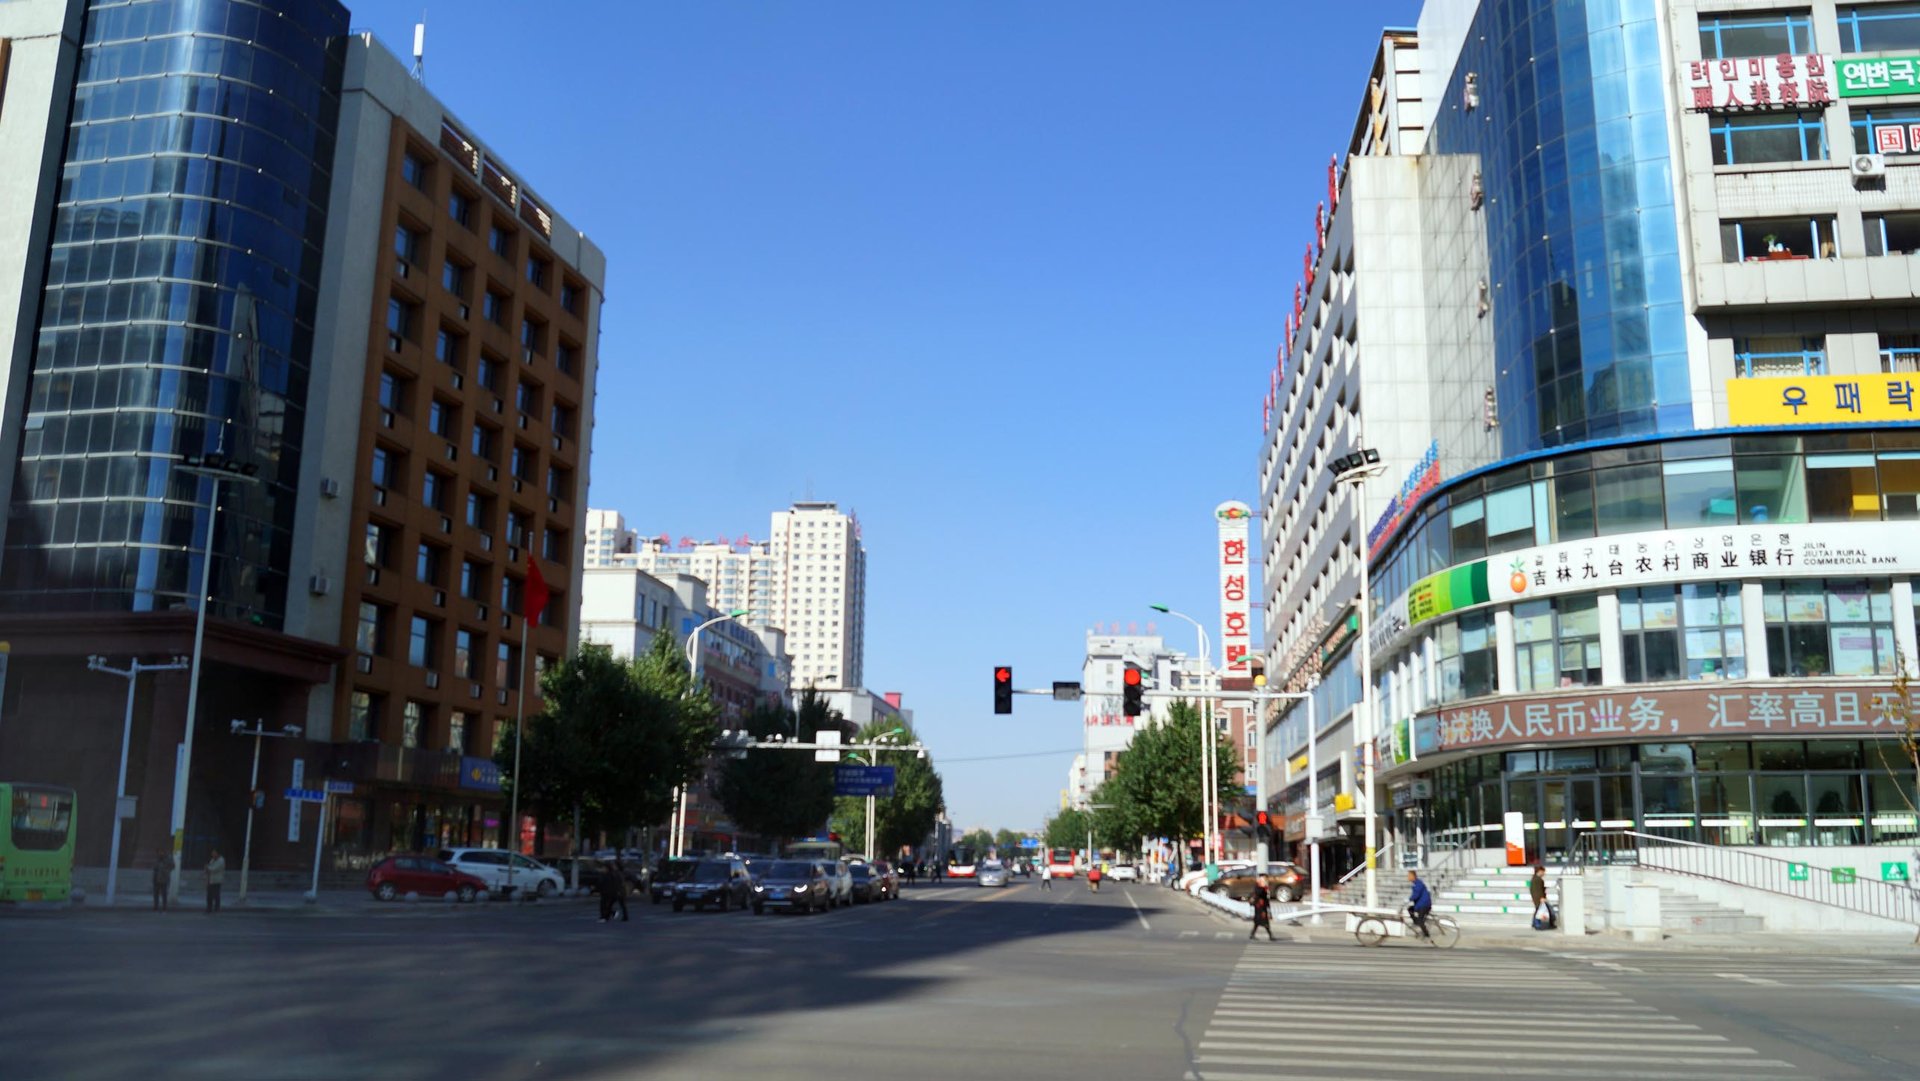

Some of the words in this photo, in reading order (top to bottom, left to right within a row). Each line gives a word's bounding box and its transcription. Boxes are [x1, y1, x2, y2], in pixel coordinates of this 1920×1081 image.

[1690, 53, 1825, 83] 려인미용원
[1691, 78, 1830, 108] 丽人美容院
[1532, 548, 1795, 586] 吉林九台农村商业银行
[1803, 557, 1867, 565] COMMERCIAL
[1872, 556, 1898, 564] BANK
